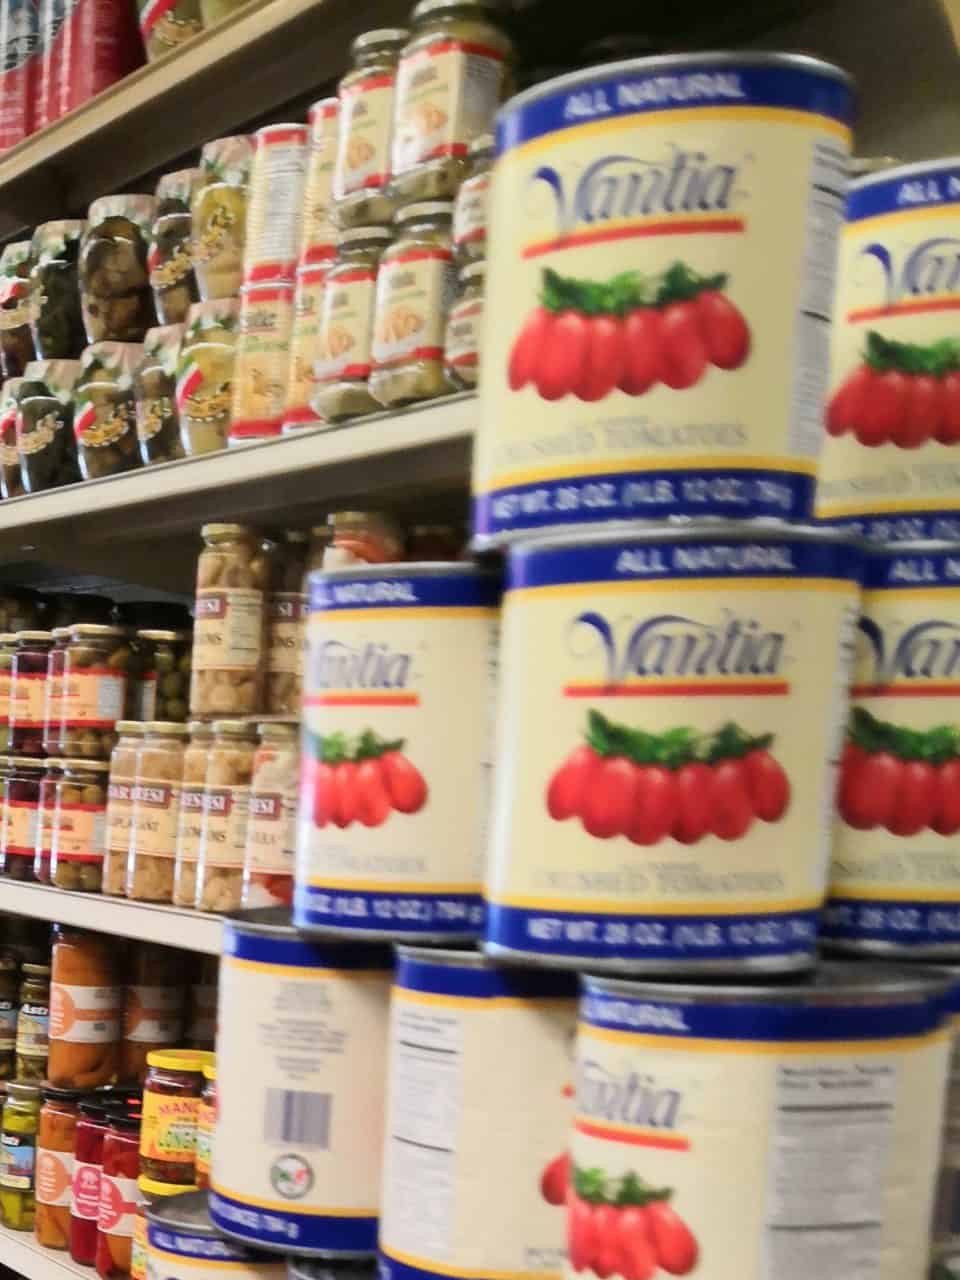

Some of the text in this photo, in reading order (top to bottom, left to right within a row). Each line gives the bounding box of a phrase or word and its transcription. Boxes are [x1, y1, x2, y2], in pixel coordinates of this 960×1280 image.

[564, 73, 745, 118] ALL NATURAL
[616, 544, 797, 574] ALL NATURAL
